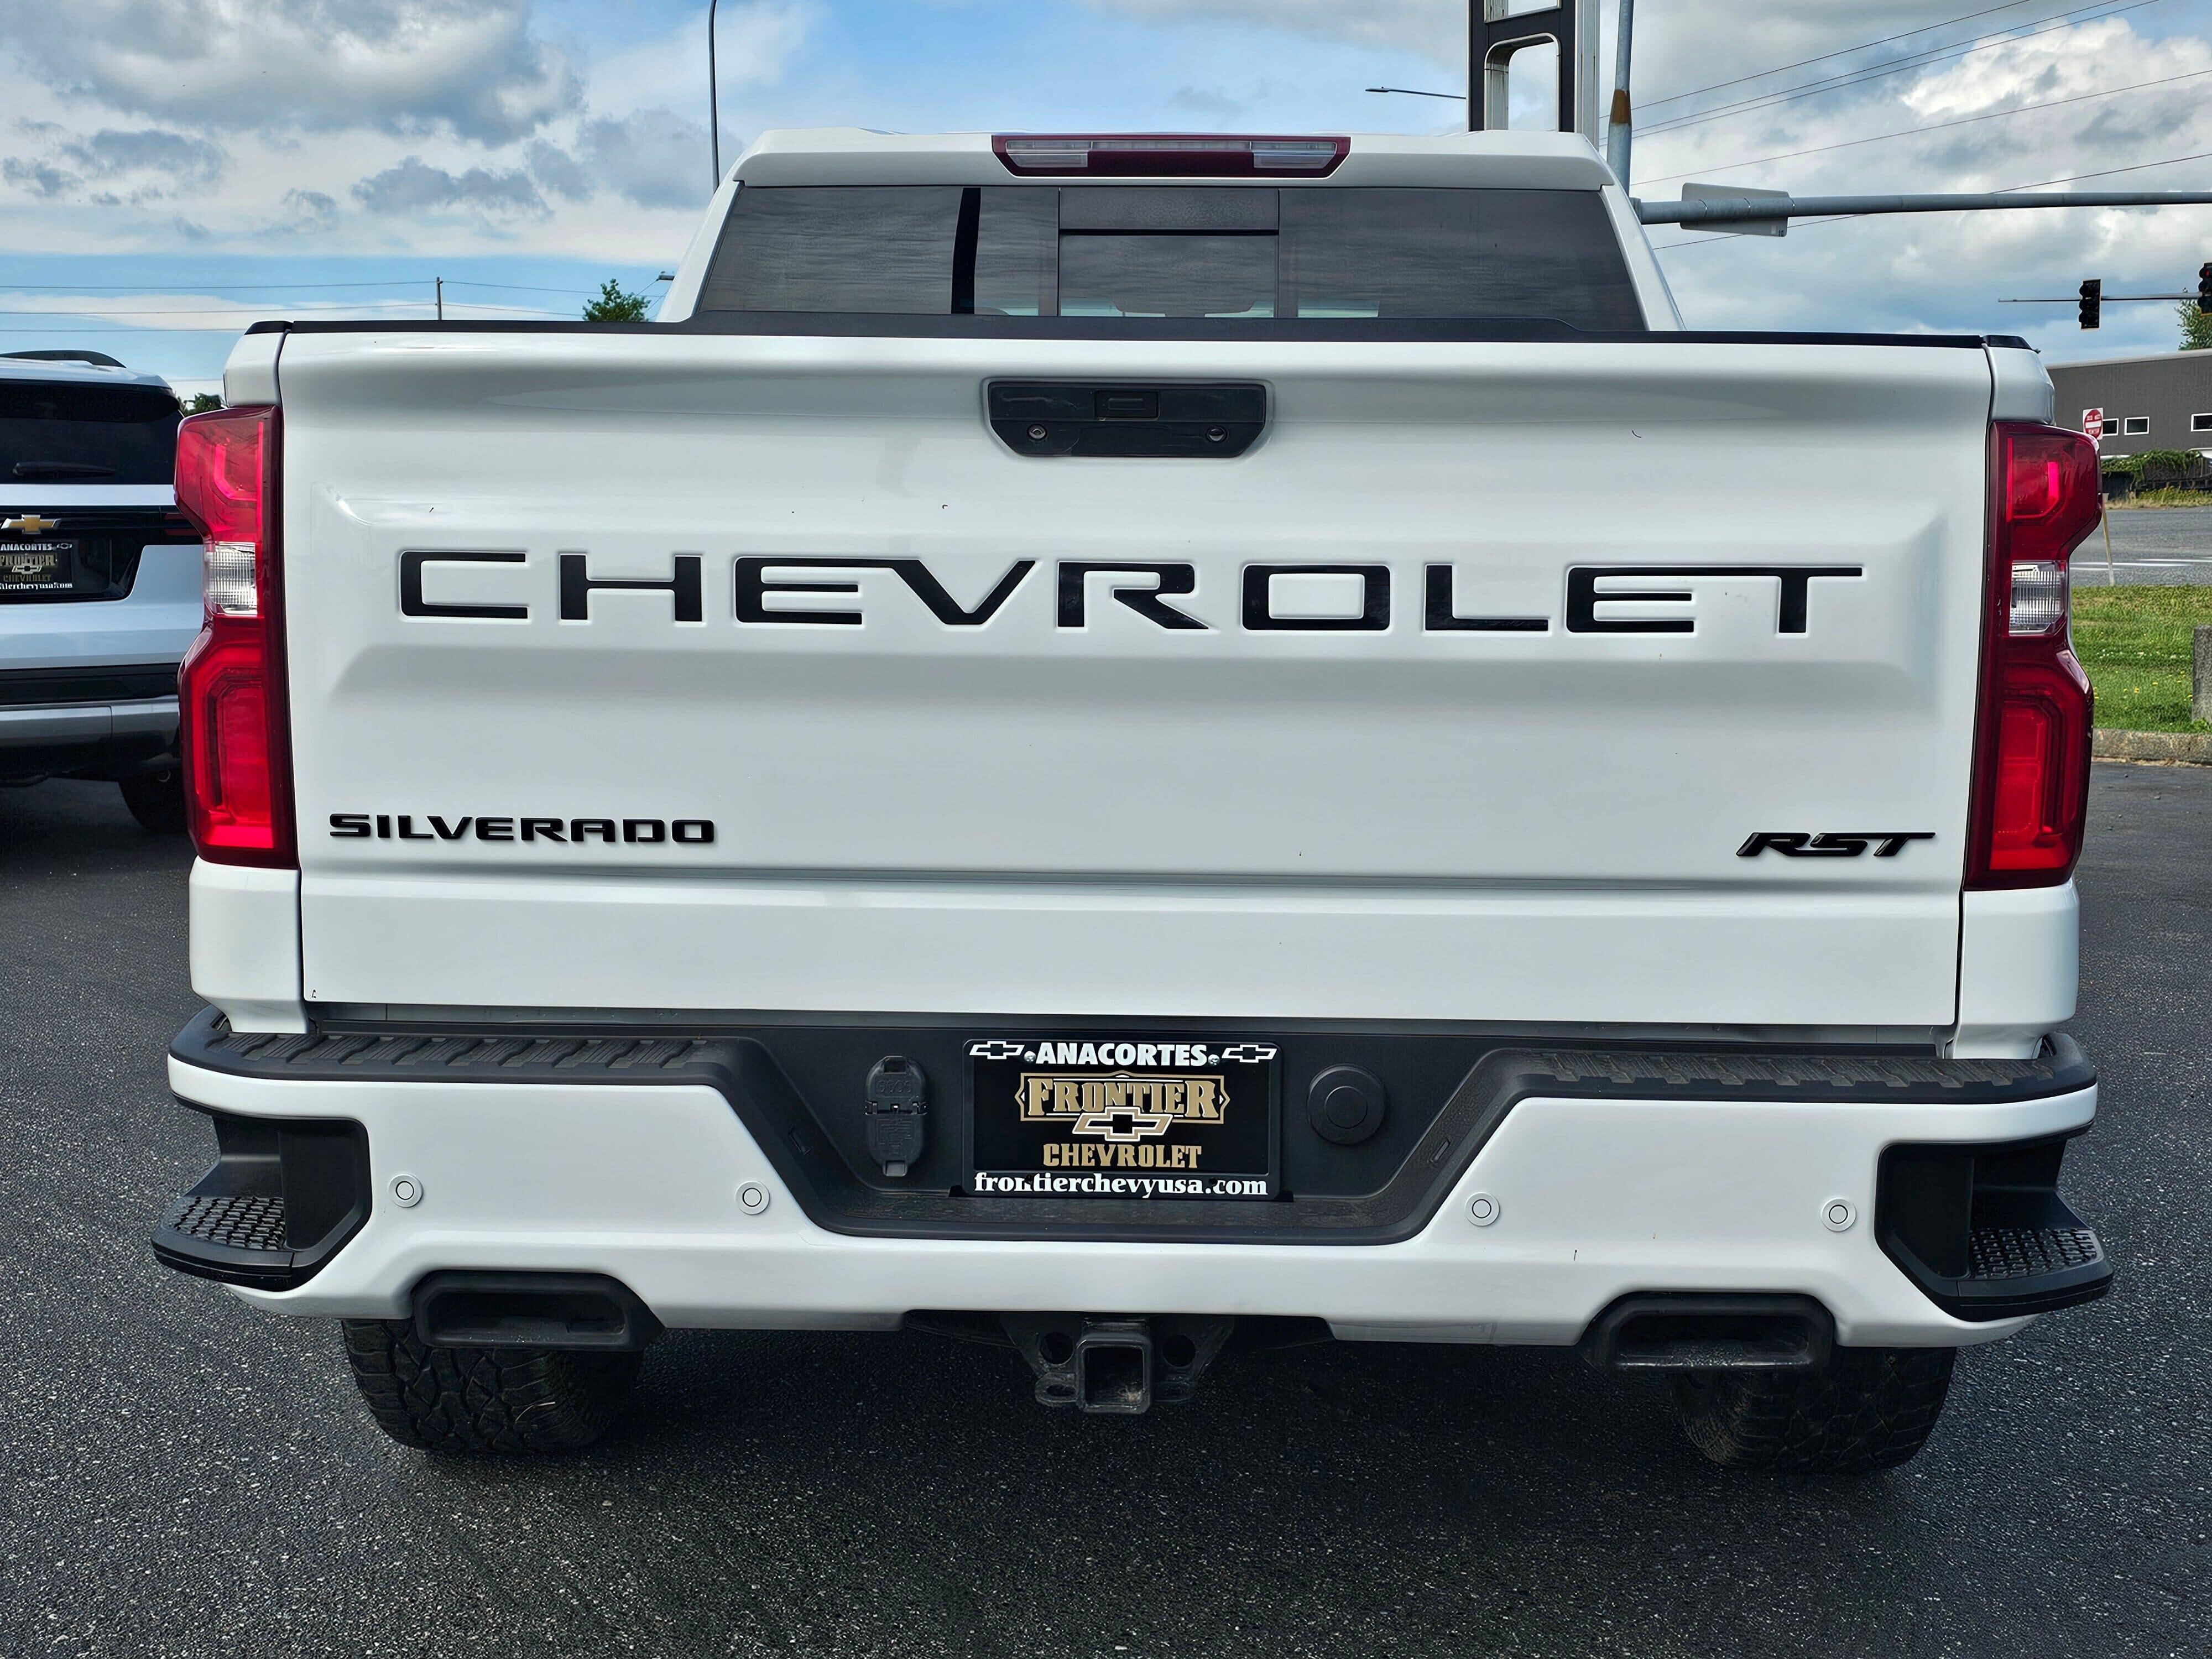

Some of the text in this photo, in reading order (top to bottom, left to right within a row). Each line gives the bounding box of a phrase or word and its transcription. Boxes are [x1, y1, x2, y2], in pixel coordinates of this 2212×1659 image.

[400, 551, 1863, 634] CHEVROLET
[330, 813, 715, 843] SILVERADO
[1736, 832, 1936, 857] RST
[1035, 1042, 1207, 1066] ANACORTES
[1027, 1078, 1219, 1119] FRONTIER
[1043, 1143, 1202, 1168] CHEVROLET
[974, 1172, 1269, 1198] frontierchevyusa.com
